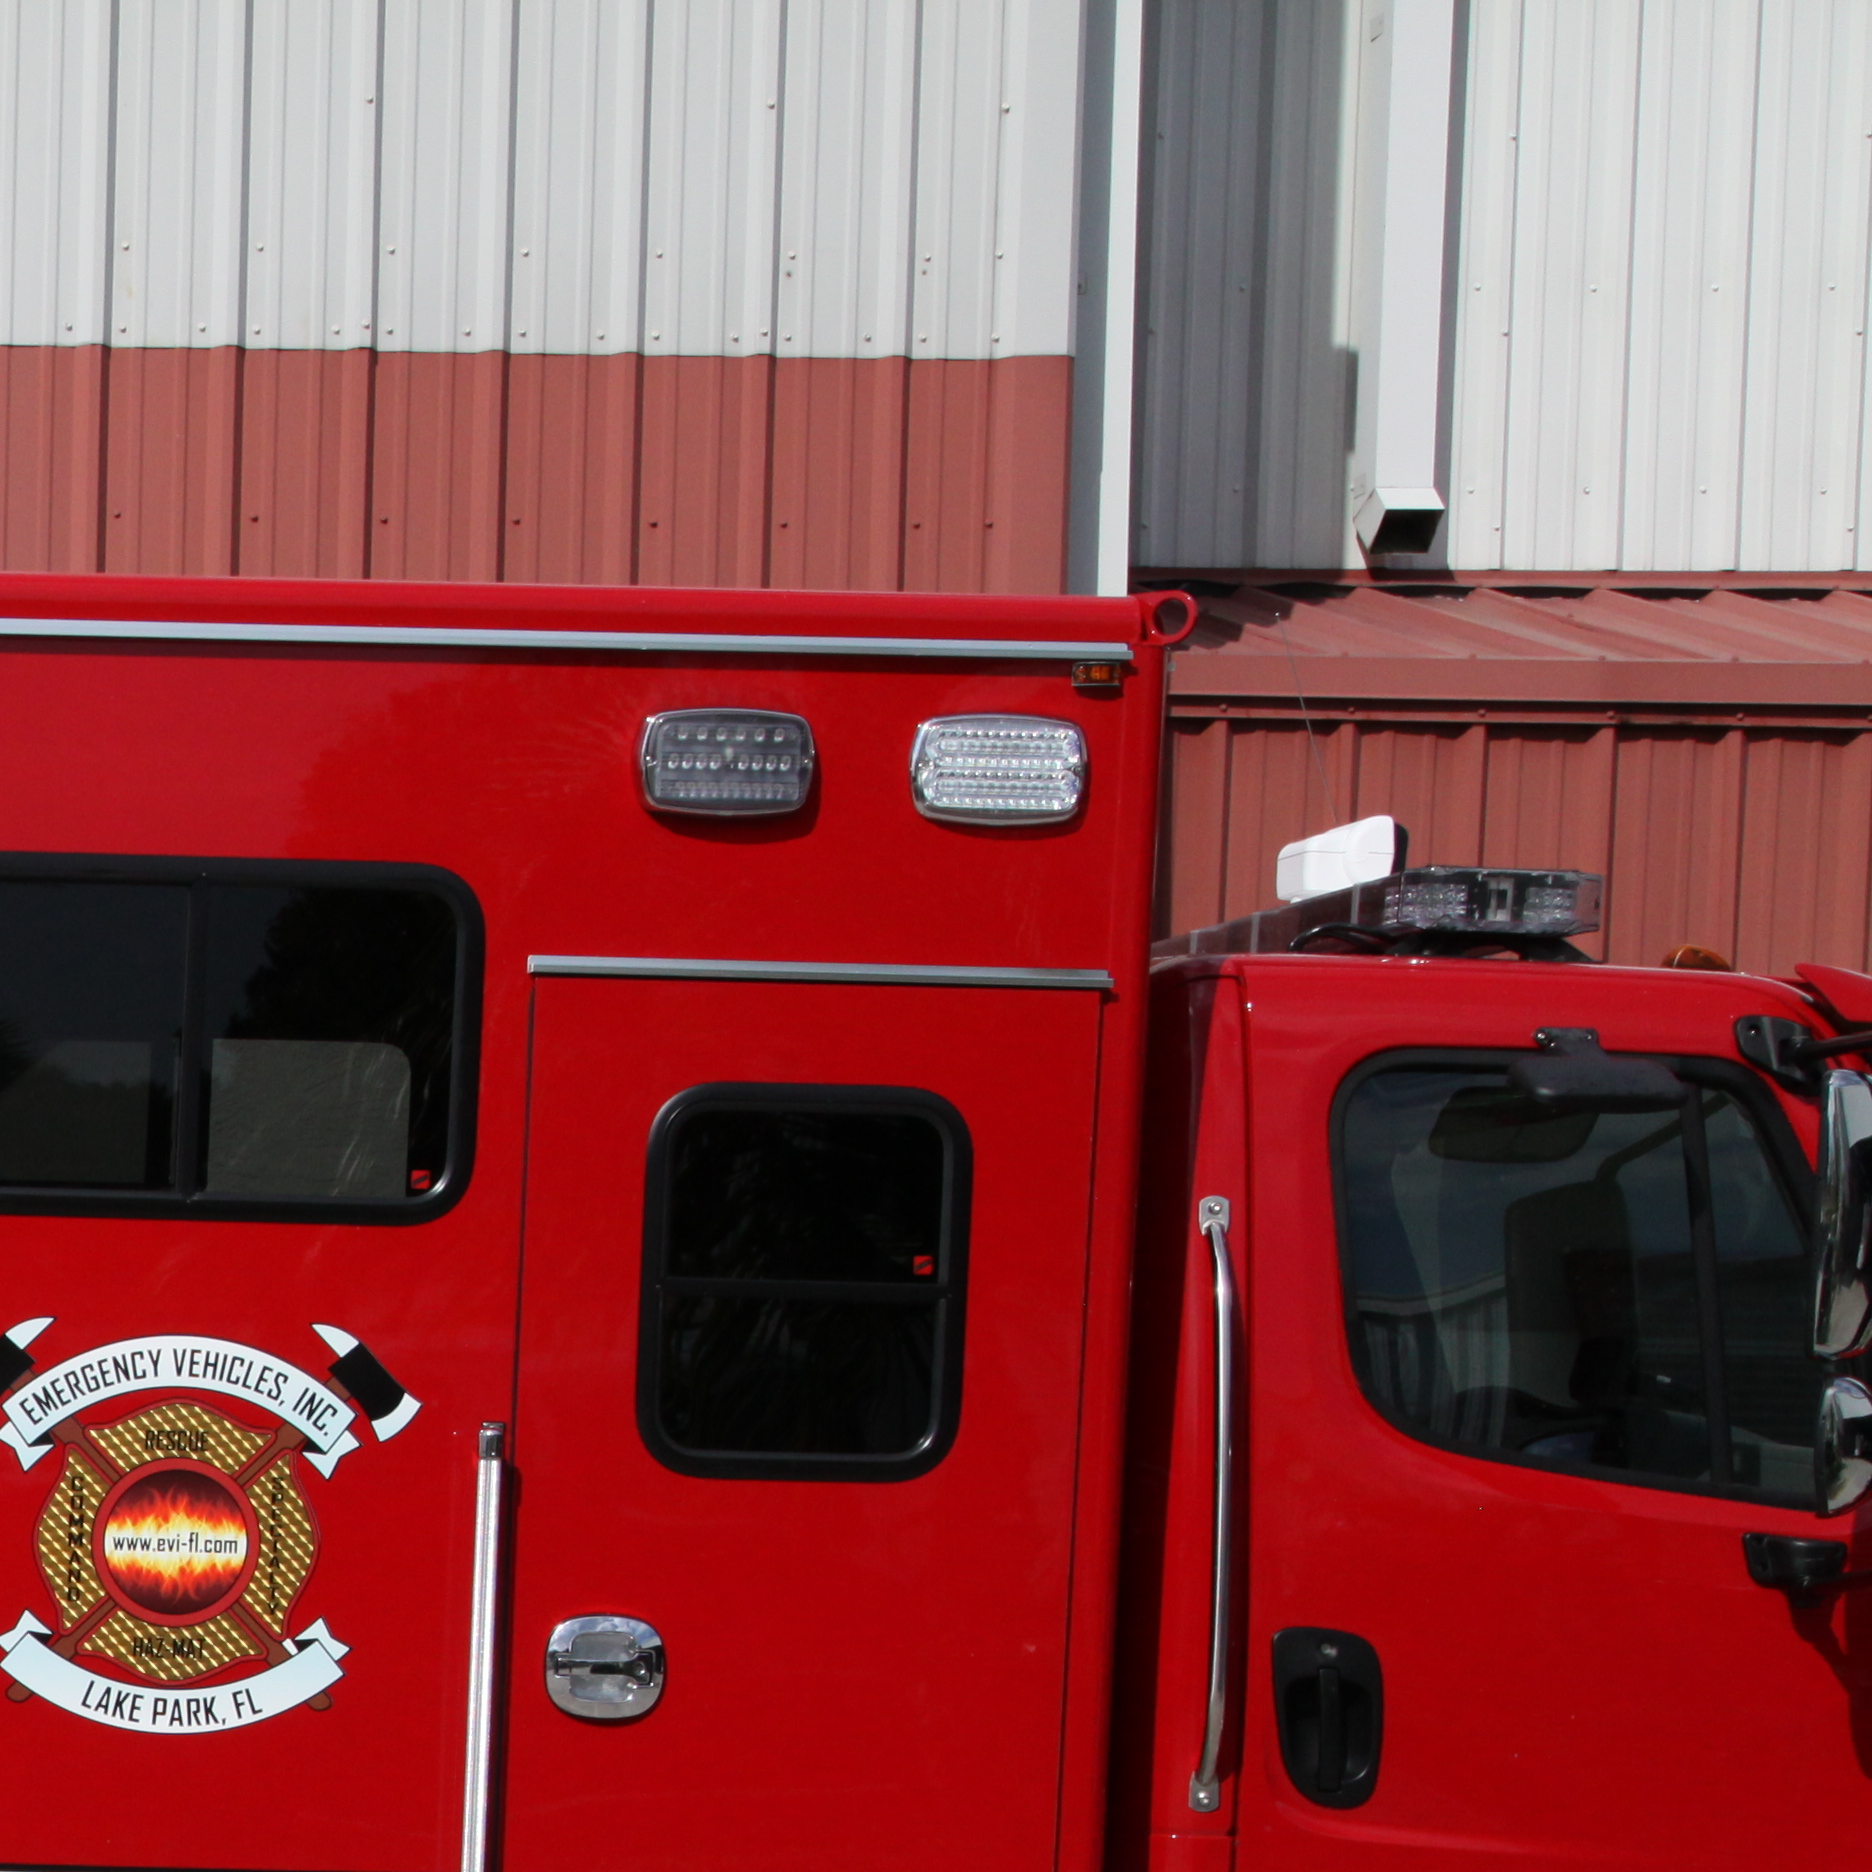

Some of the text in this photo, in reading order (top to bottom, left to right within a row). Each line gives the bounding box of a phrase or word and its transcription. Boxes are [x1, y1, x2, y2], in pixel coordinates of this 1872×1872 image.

[19, 1348, 338, 1437] EMERGENCY VEHICLES, INC.
[145, 1429, 209, 1451] RESCUE
[67, 1476, 84, 1601] COMMAND
[113, 1532, 239, 1555] www.evi-fl.com
[267, 1476, 284, 1616] SPECIALTY
[132, 1637, 206, 1660] HAZ-MAT
[81, 1680, 264, 1727] LAKE PARK, FL
